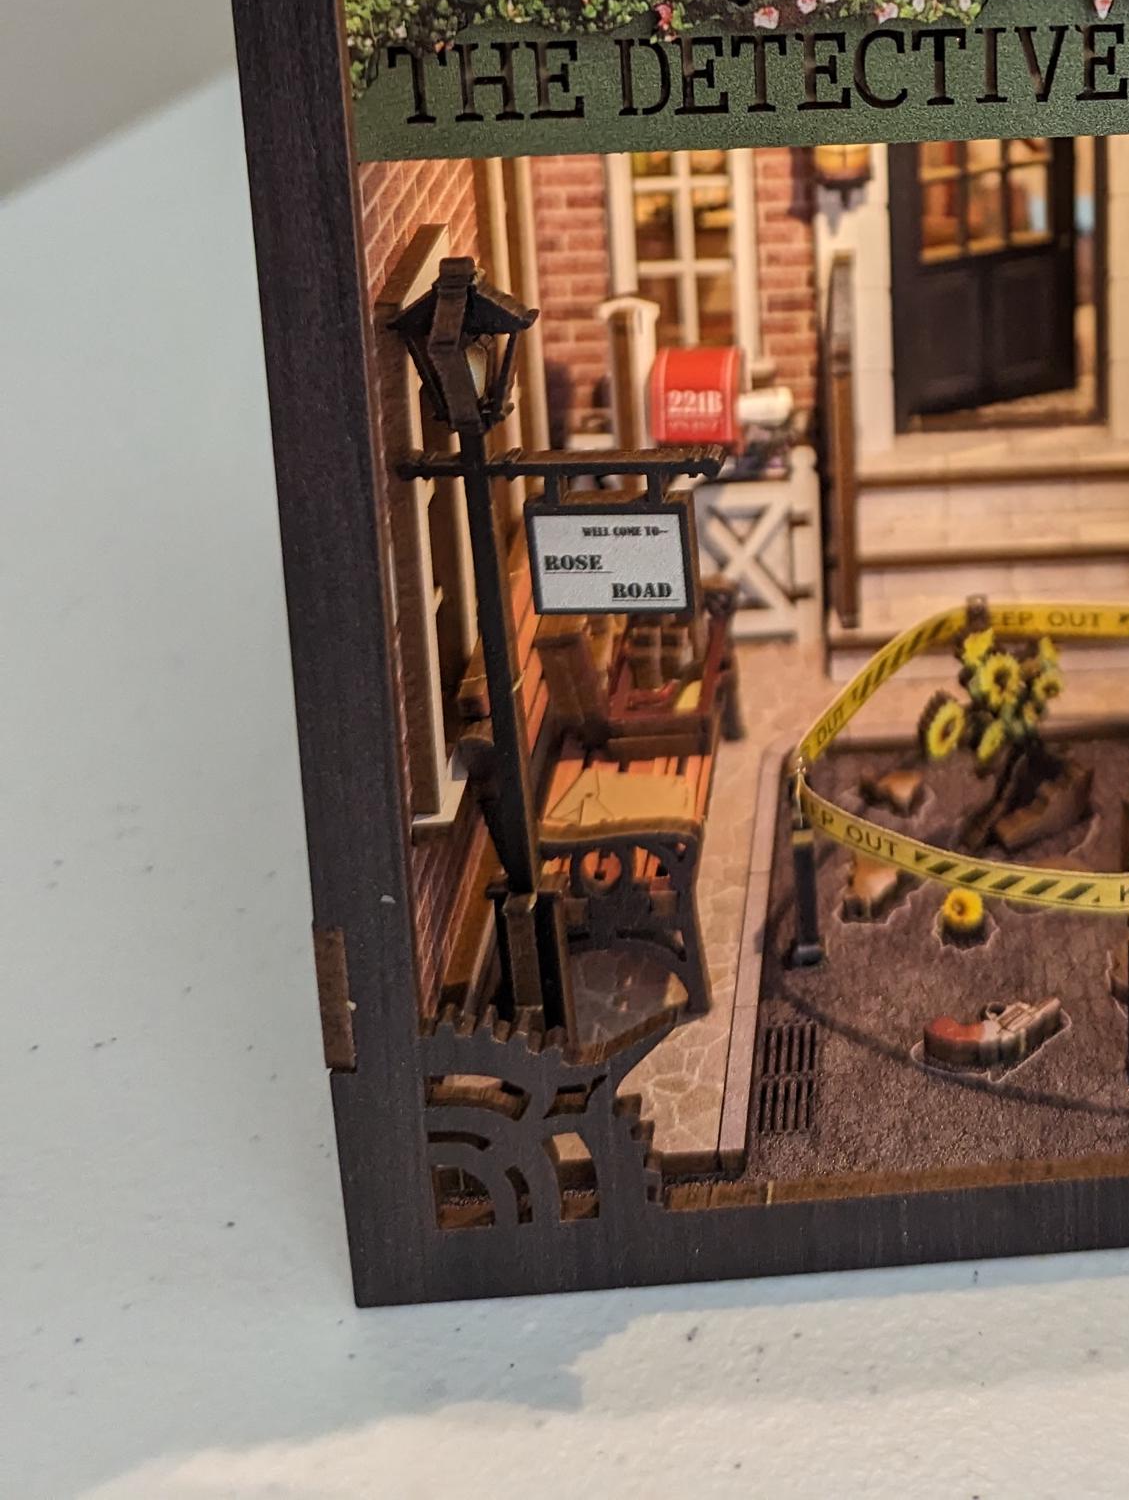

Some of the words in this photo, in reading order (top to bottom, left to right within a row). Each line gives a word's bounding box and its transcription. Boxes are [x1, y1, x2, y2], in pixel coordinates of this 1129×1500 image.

[387, 39, 585, 125] THE
[614, 22, 1129, 117] DETECTIVE
[667, 389, 723, 414] 221B
[582, 525, 609, 537] WELL
[613, 525, 641, 537] COME
[543, 554, 603, 571] ROSE
[611, 582, 672, 599] ROAD
[1047, 610, 1100, 628] OUT
[845, 823, 898, 857] OUT
